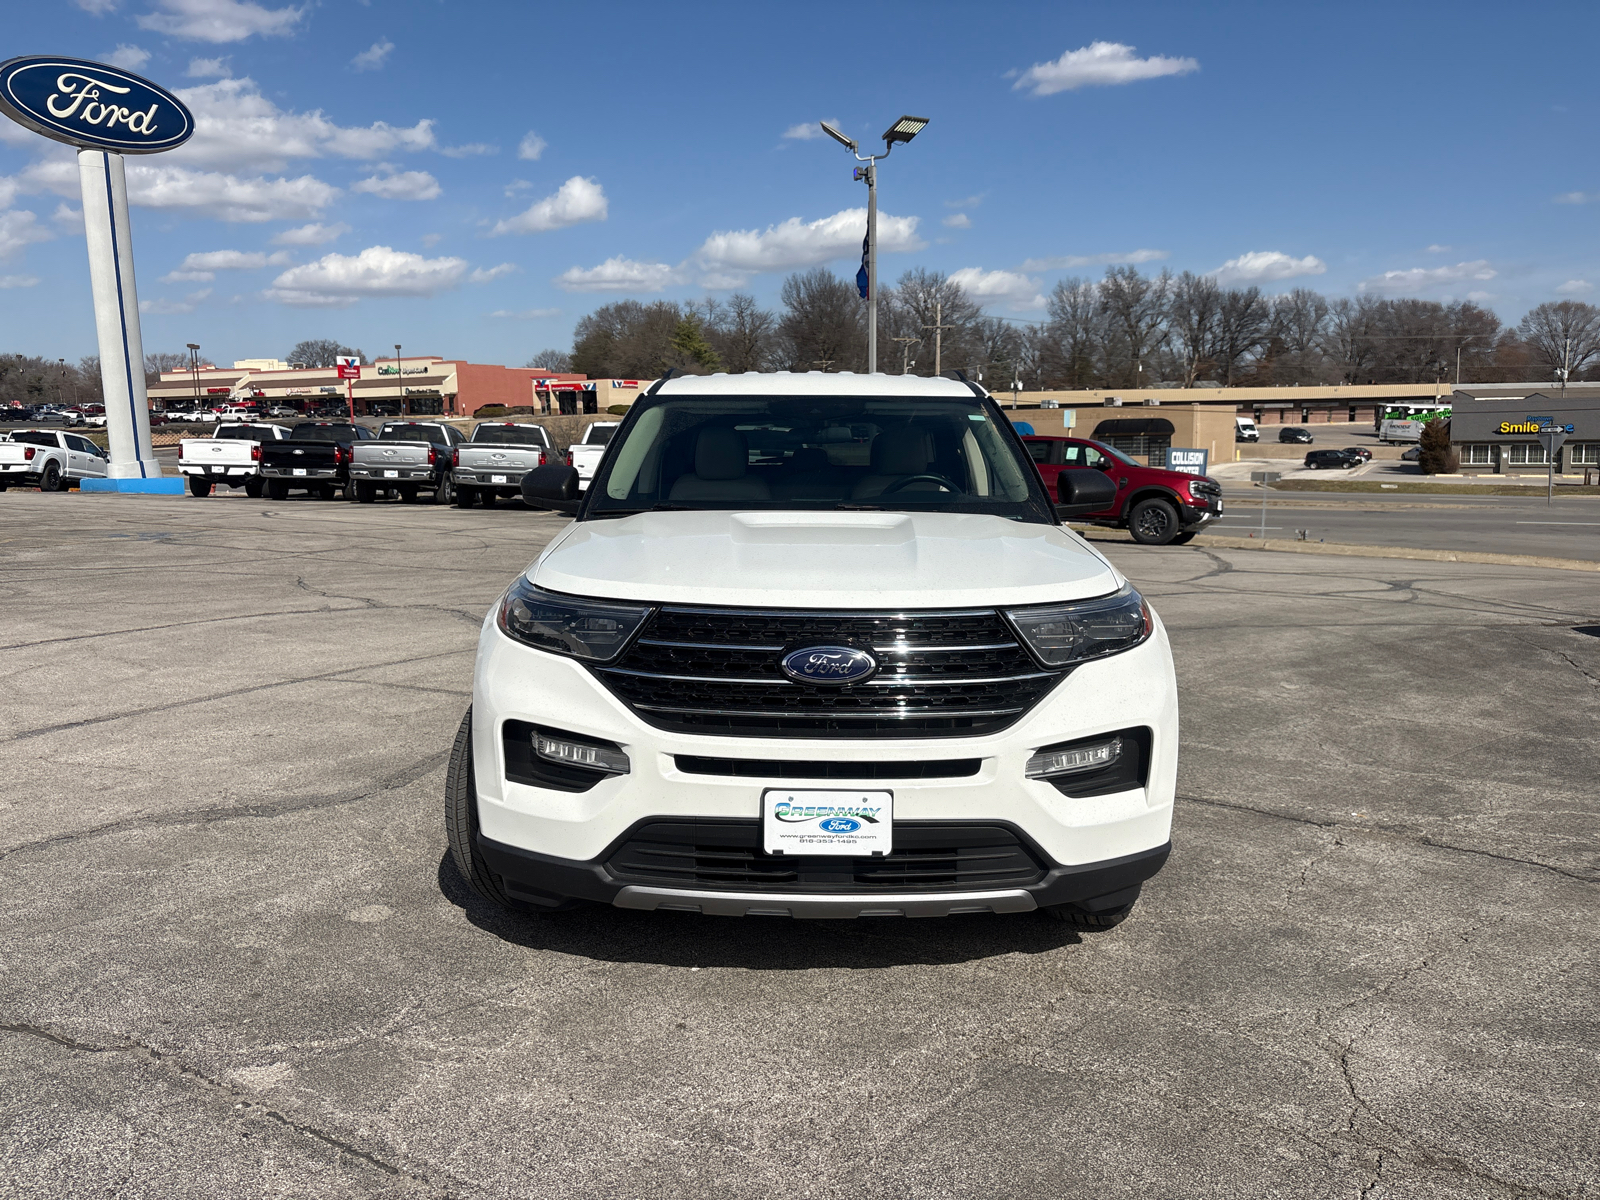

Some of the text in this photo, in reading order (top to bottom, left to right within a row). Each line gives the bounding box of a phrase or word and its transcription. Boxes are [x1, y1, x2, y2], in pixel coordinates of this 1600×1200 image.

[47, 73, 159, 135] Ford
[1500, 421, 1539, 433] Smile
[1171, 451, 1204, 465] COLLISION
[804, 653, 854, 674] Ford
[775, 802, 882, 817] GREENWAY
[828, 820, 851, 831] Ford
